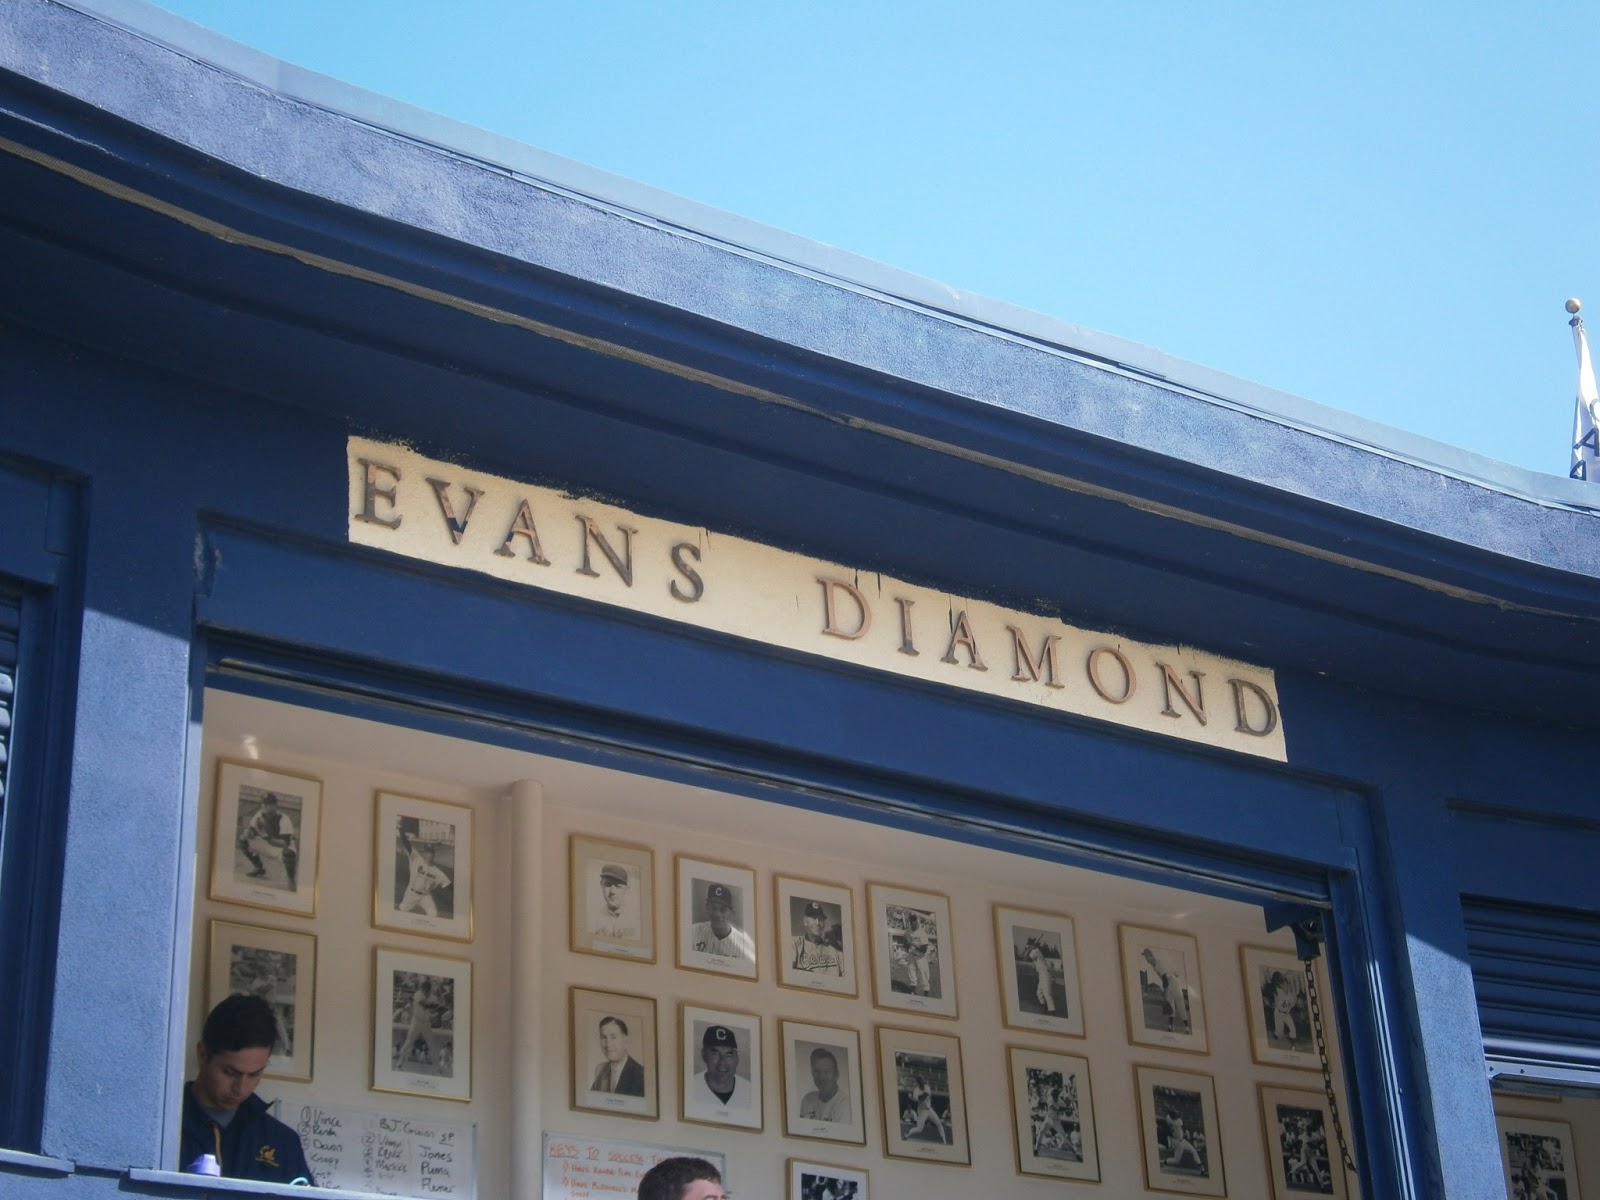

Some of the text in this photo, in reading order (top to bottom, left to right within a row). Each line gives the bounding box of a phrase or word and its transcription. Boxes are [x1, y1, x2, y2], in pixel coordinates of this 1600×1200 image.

[354, 457, 1279, 737] EVANS DIAMOND
[418, 1144, 453, 1163] Jones
